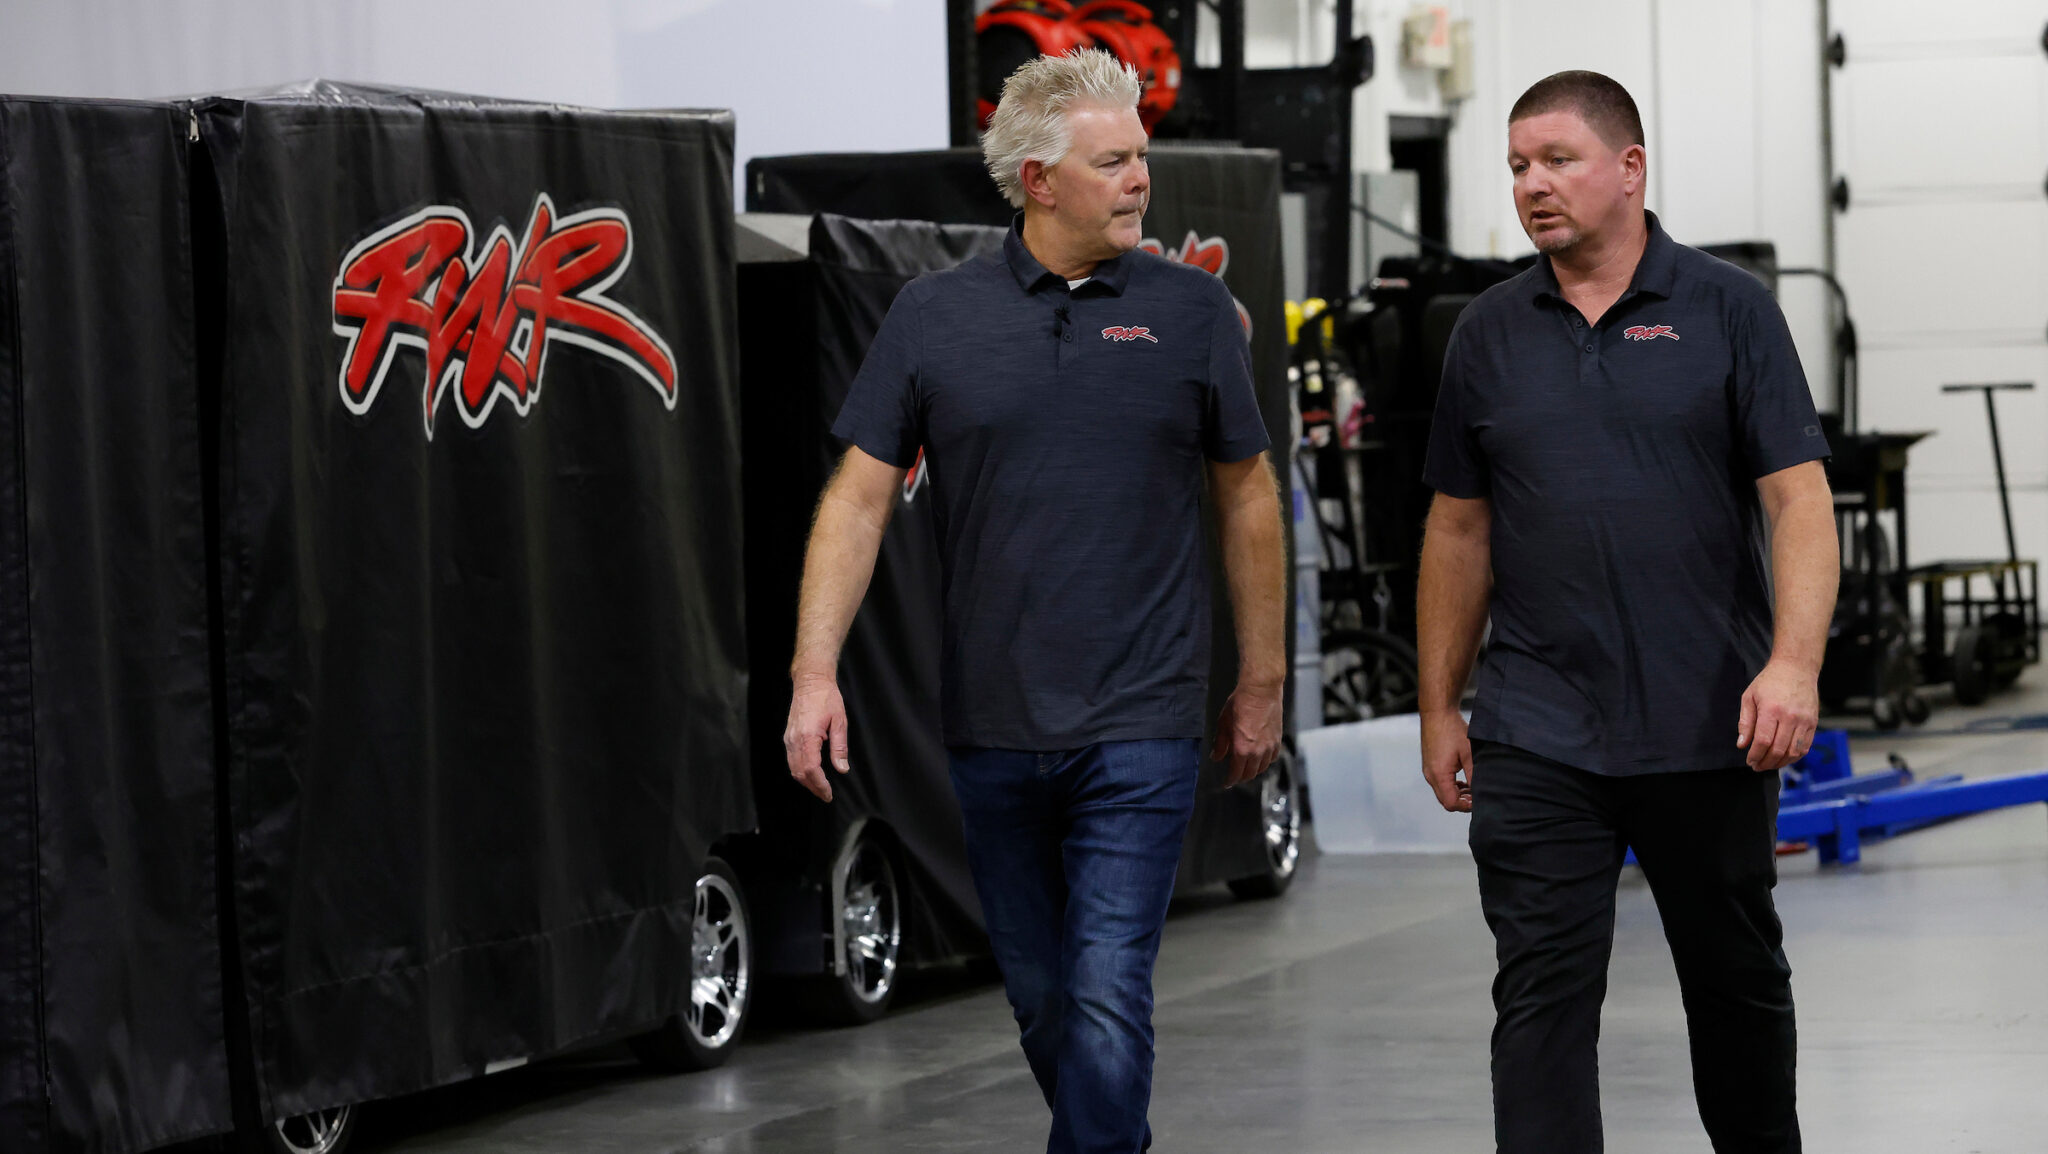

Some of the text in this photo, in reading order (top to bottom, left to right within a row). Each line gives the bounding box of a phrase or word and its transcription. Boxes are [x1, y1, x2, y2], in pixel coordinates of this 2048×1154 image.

[333, 192, 677, 441] RWR
[1102, 326, 1158, 343] RWR
[1624, 325, 1679, 341] RWR
